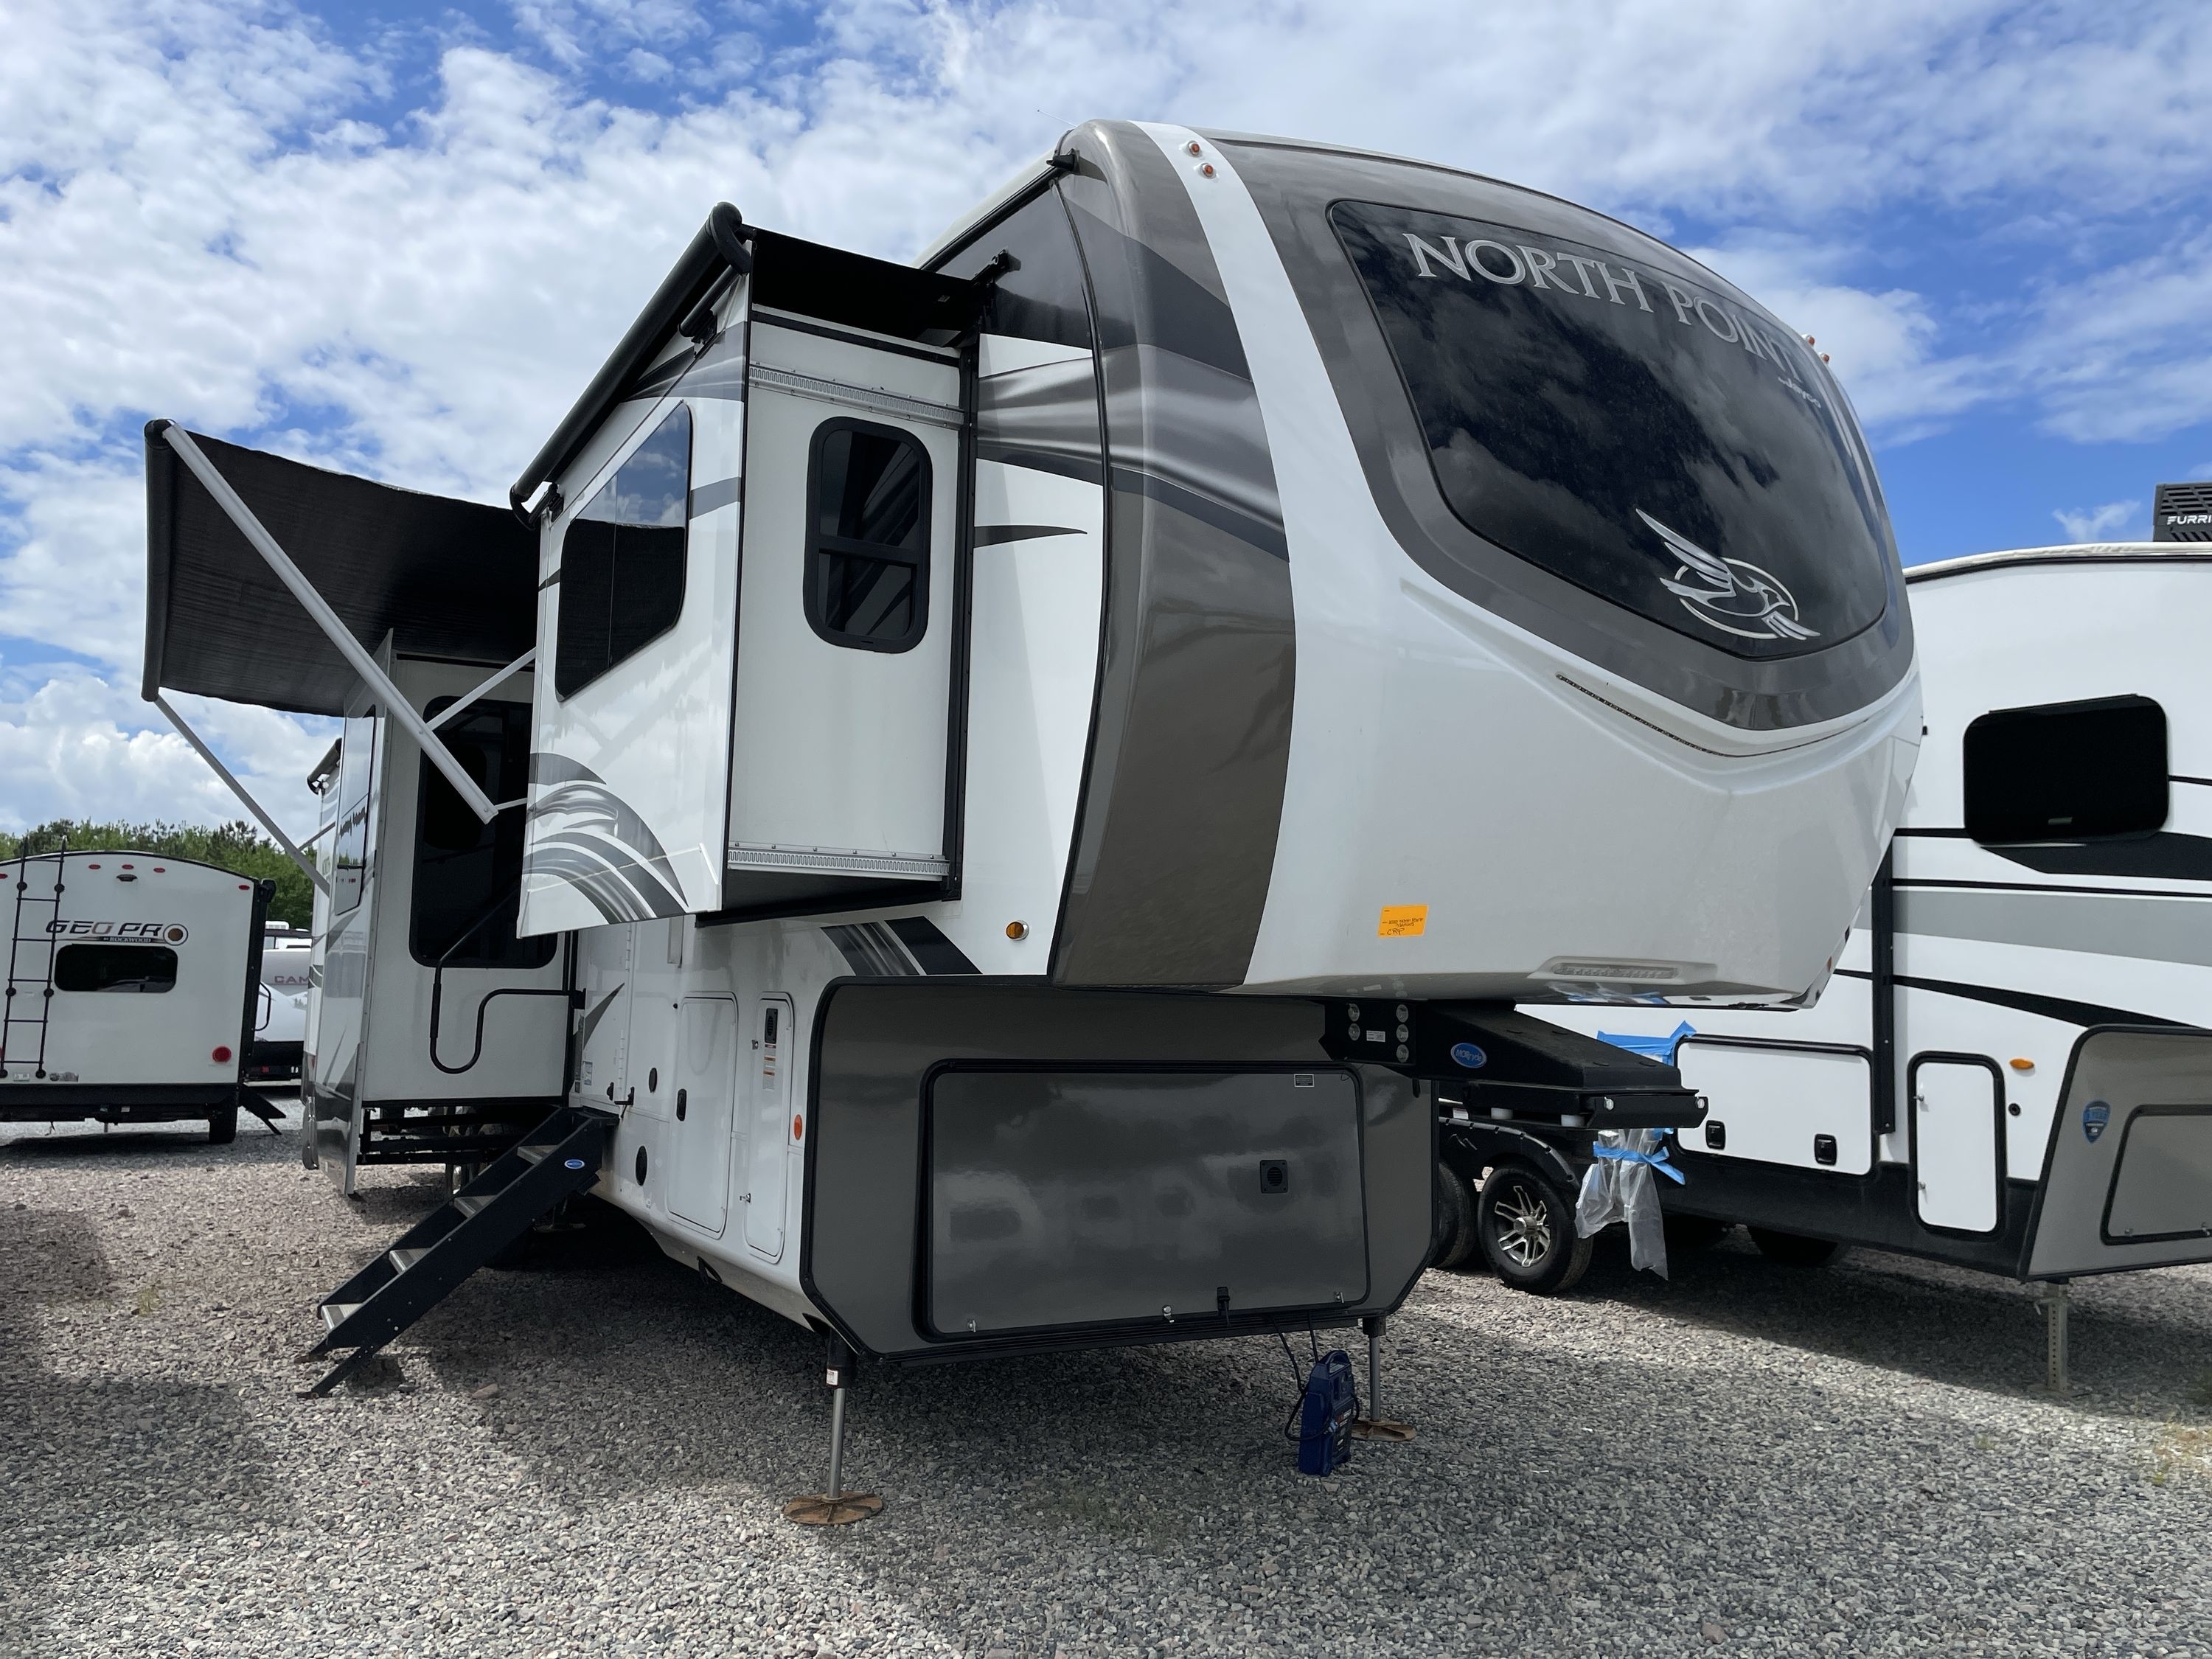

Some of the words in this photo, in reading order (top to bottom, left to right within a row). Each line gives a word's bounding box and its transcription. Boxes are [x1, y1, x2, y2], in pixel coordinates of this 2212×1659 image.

[1402, 233, 1654, 313] NORTH
[1660, 281, 1802, 383] POINT
[2167, 515, 2212, 525] FURRI
[46, 920, 114, 935] GEO
